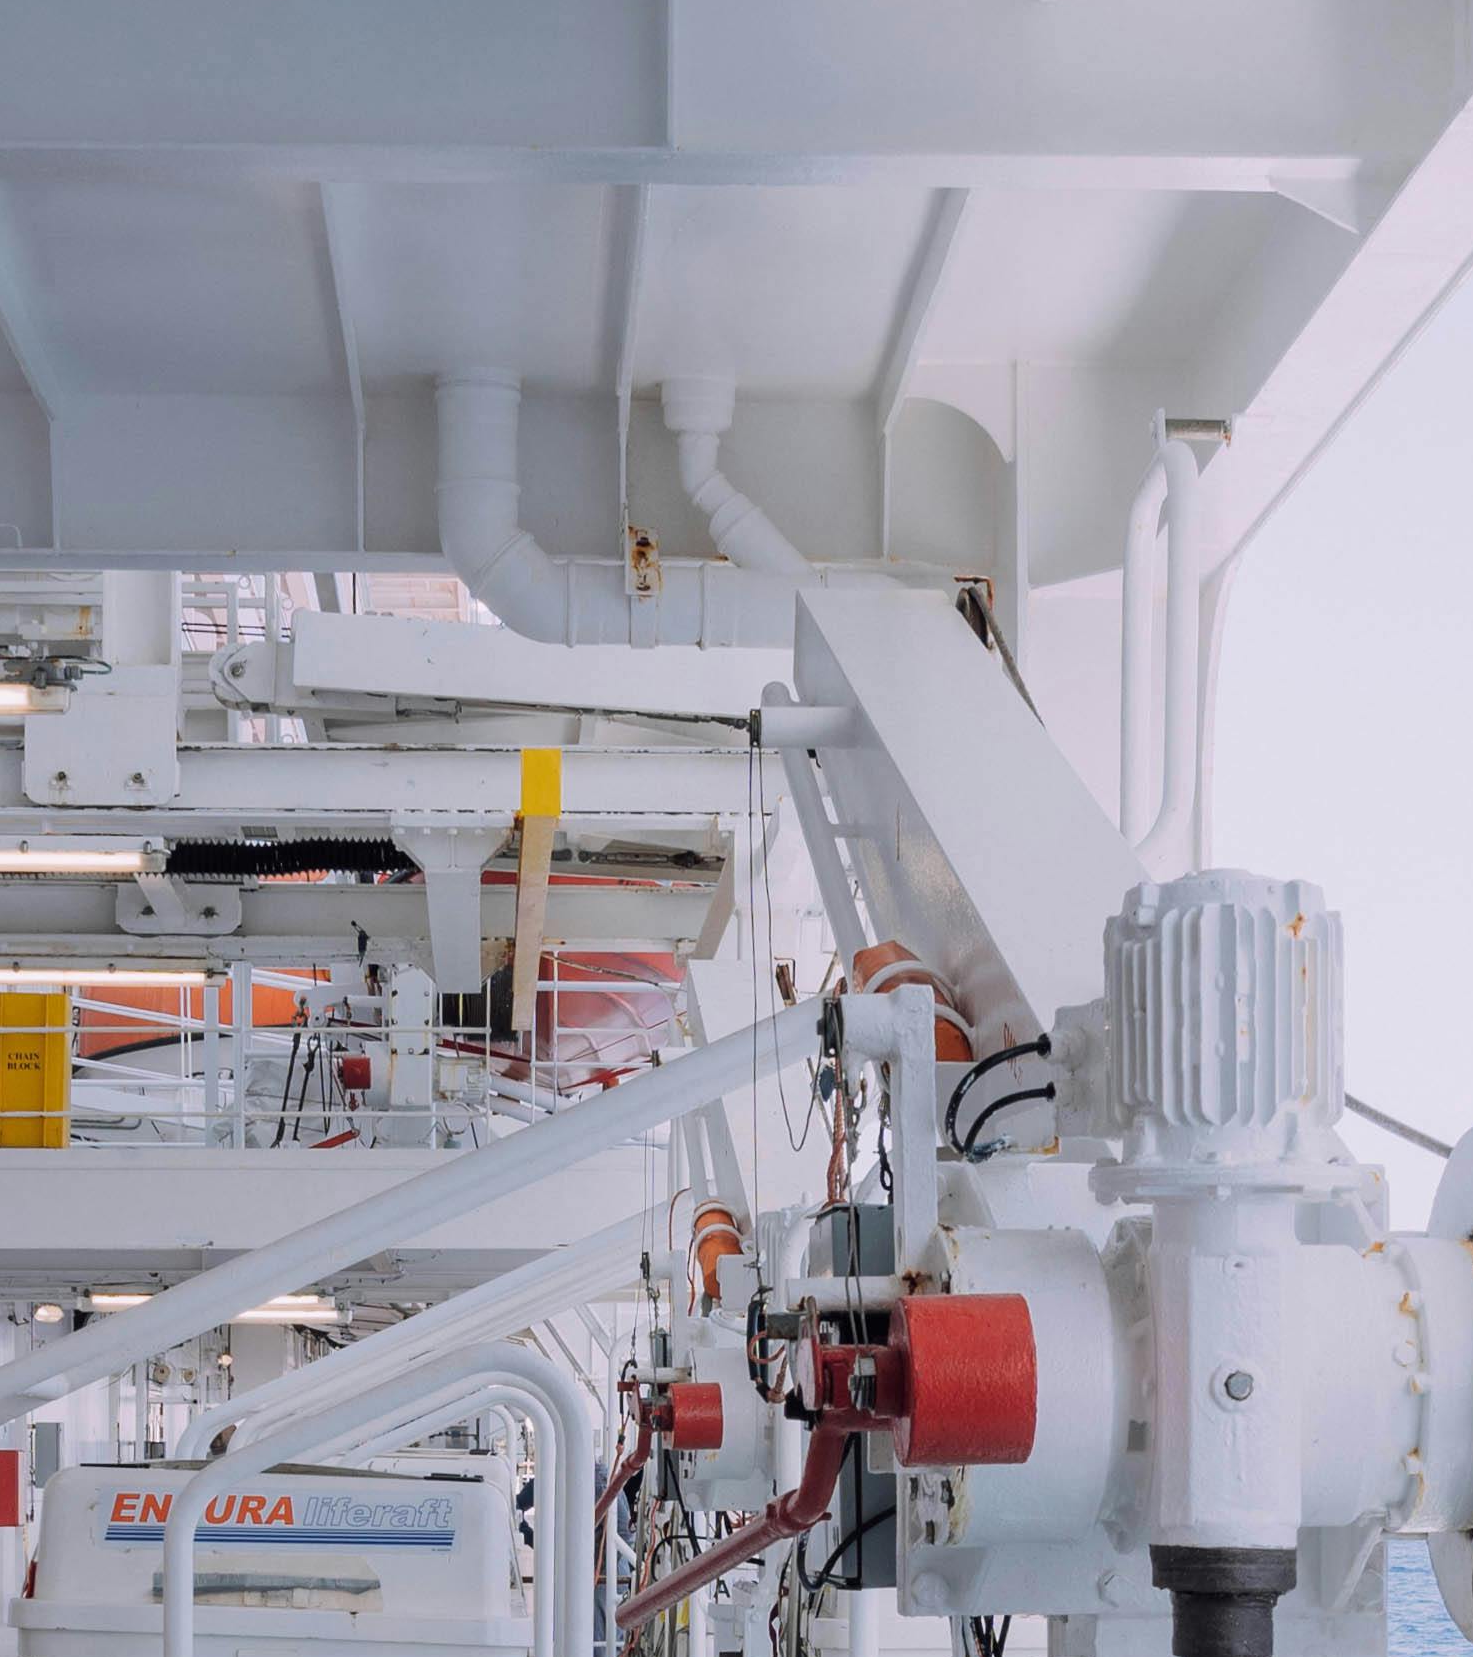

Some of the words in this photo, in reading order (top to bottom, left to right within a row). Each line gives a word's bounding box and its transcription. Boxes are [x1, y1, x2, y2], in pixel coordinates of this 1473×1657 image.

[8, 1052, 39, 1060] CHAIN
[7, 1062, 40, 1070] BLOCK
[110, 1493, 294, 1525] ENURA
[303, 1496, 452, 1528] liferaft
